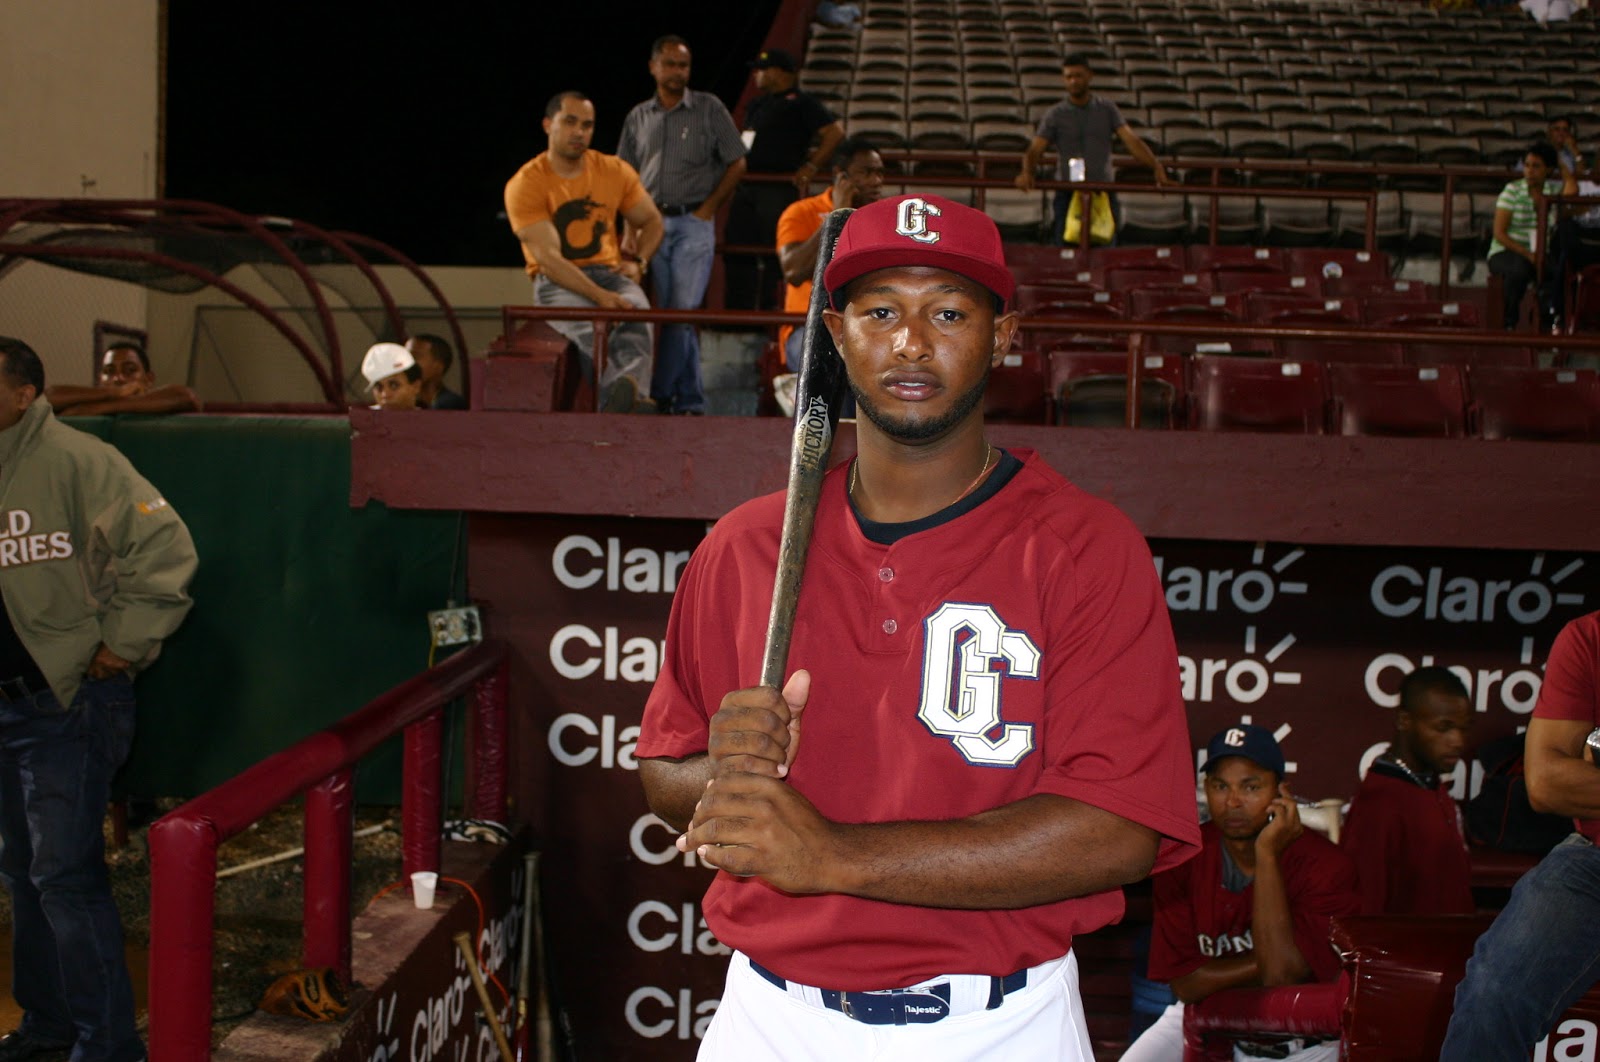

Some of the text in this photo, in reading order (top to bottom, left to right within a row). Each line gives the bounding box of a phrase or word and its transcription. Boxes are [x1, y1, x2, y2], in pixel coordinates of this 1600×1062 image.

[895, 198, 942, 245] GC
[801, 397, 828, 467] HICKORY
[0, 531, 74, 567] RIES
[1152, 556, 1275, 613] aro
[1370, 564, 1552, 624] Claro
[549, 624, 665, 682] Cla
[915, 600, 1043, 769] GC
[1364, 653, 1543, 714] Cro
